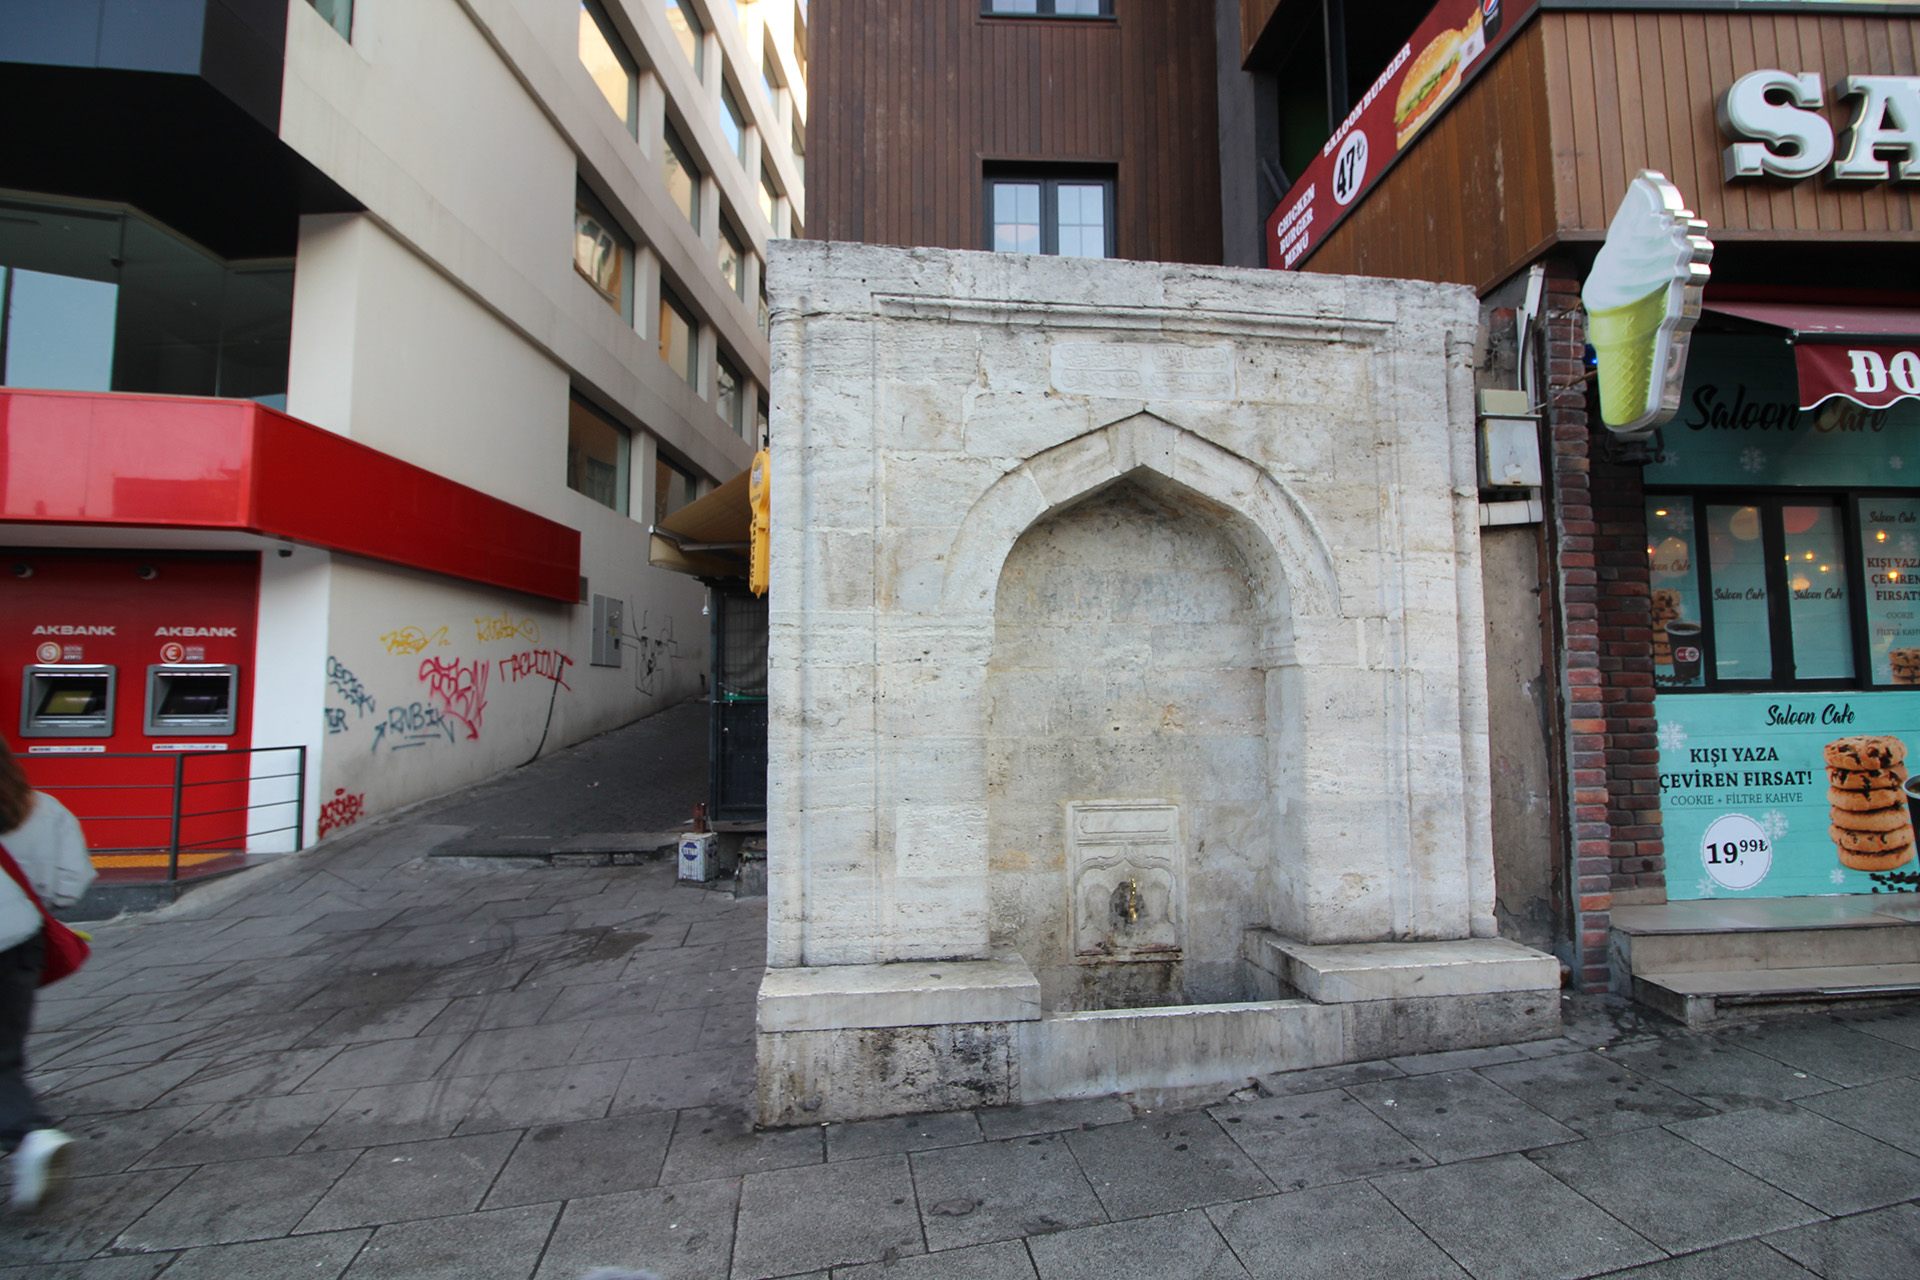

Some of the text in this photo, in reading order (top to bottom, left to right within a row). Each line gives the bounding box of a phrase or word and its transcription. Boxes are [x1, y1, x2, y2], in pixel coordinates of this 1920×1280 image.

[1323, 42, 1411, 158] SALOON BURGER
[1277, 183, 1315, 237] CHICKEN
[1280, 207, 1314, 255] BURGER
[1684, 384, 1800, 431] Saloon
[1894, 557, 1920, 568] YAZ
[32, 625, 117, 636] AKBANK
[154, 626, 237, 638] AKBANK
[1765, 703, 1855, 726] Saloon Cafe
[1690, 747, 1779, 767] KIŞI YAZA
[1659, 769, 1813, 793] ÇEVİREN FIRSAT!
[1671, 795, 1714, 806] COOKIE
[1726, 792, 1762, 804] FİLTRE
[1765, 793, 1804, 803] KAHVE
